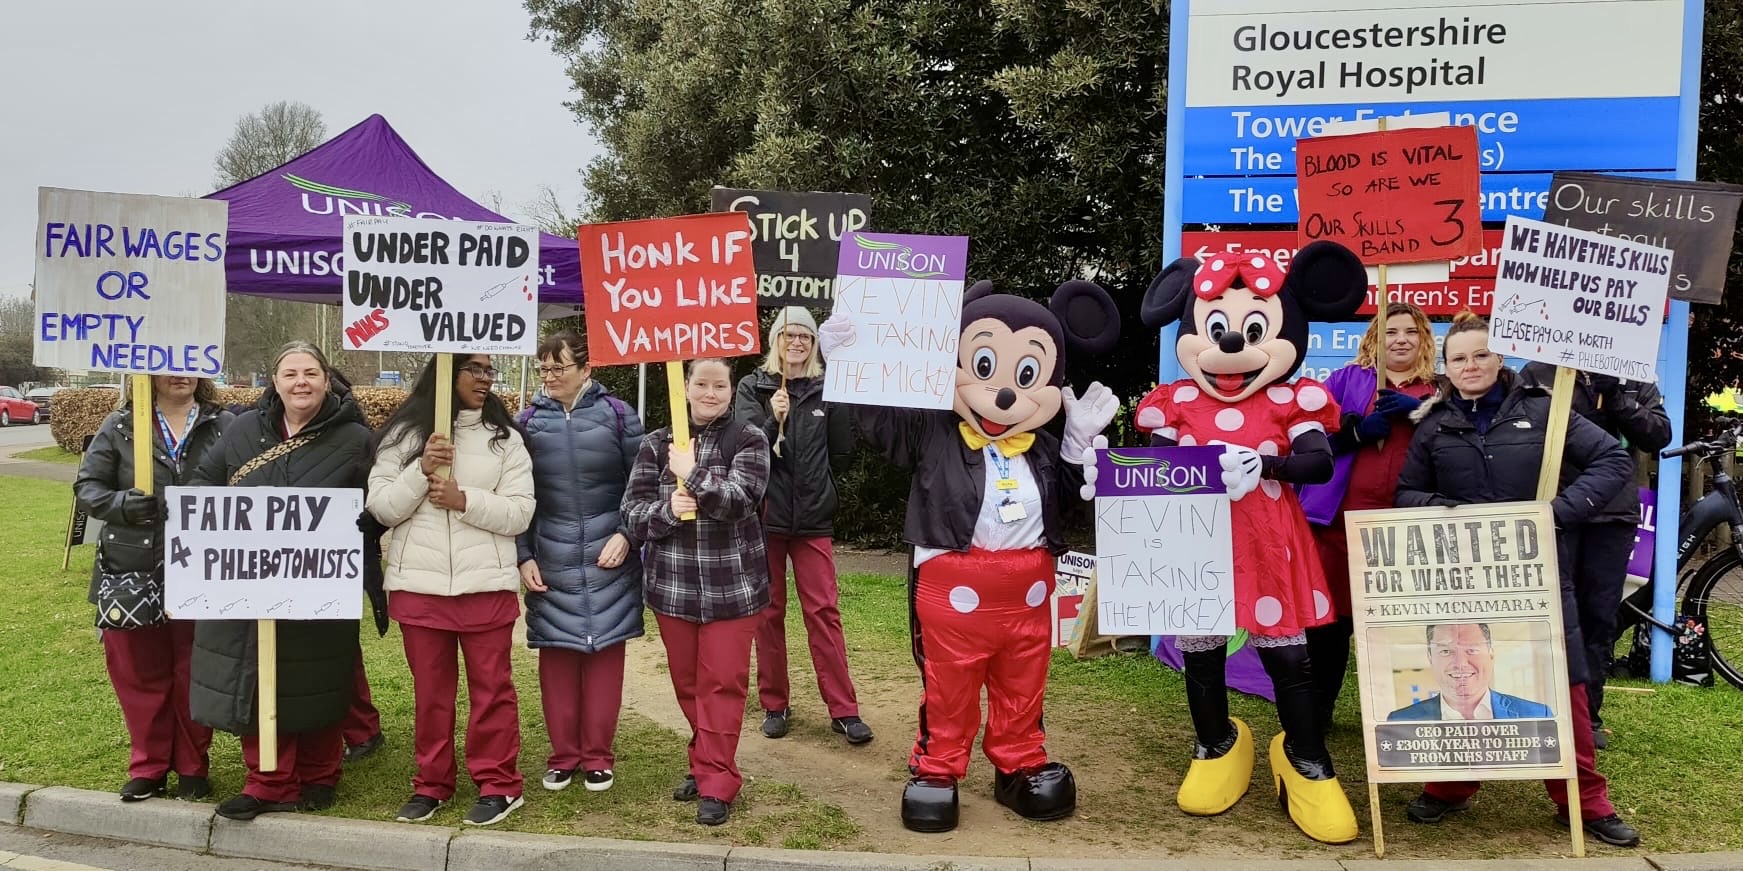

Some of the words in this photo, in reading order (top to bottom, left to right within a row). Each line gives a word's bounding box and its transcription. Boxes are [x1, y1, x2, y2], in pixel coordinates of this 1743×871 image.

[1233, 17, 1507, 52] Gloucestershire
[1232, 61, 1325, 97] Royal
[1339, 56, 1485, 94] Hospital
[1231, 146, 1282, 170] The
[1304, 153, 1361, 177] BLOOD
[1371, 152, 1388, 166] IS
[1402, 144, 1463, 165] VITAL
[1229, 188, 1283, 213] The
[1480, 187, 1549, 211] entre
[1327, 182, 1353, 197] SO
[1365, 177, 1400, 193] ARE
[1409, 172, 1441, 187] WE
[1555, 183, 1620, 216] Our
[1627, 192, 1715, 223] skills
[828, 208, 867, 241] UP
[1305, 213, 1345, 239] OUR
[1351, 211, 1405, 238] SKILLS
[1362, 239, 1420, 257] BAND
[1431, 199, 1464, 246] 3
[46, 222, 116, 258] FAIR
[121, 226, 222, 262] WAGES
[353, 231, 450, 265] UNDER
[459, 233, 529, 268] PAID
[601, 231, 700, 274] HONK
[711, 231, 748, 265] IF
[779, 239, 799, 272] 4
[1511, 225, 1540, 253] WE
[1543, 231, 1588, 263] HAVE
[1588, 241, 1615, 267] THE
[1616, 247, 1669, 275] SKILLS
[858, 251, 946, 273] UNISON
[96, 270, 151, 300] OR
[348, 270, 443, 311] UNDER
[602, 277, 662, 313] YOU
[676, 276, 751, 308] LIKE
[1502, 259, 1539, 284] NOW
[1540, 266, 1580, 291] HELP
[1580, 273, 1601, 293] US
[1605, 277, 1638, 299] PAY
[835, 277, 963, 320] KEVIN
[1573, 296, 1601, 317] OUR
[1605, 301, 1650, 327] BILLS
[41, 312, 144, 343] EMPTY
[345, 308, 389, 348] NHS
[420, 311, 526, 342] VALUED
[605, 319, 755, 357] VAMPIRES
[868, 321, 957, 353] TAKING
[1493, 317, 1531, 342] PLEASE
[1532, 325, 1551, 344] PAY
[1552, 329, 1574, 344] OUR
[1579, 332, 1613, 350] WORTH
[91, 343, 221, 375] NEEDLES
[830, 359, 876, 393] THE
[1115, 466, 1207, 488] UNISON
[180, 495, 253, 531] FAIR
[266, 494, 332, 531] PAY
[1097, 498, 1218, 538] KEVIN
[170, 535, 192, 568] 4
[204, 547, 360, 580] PHLEBOTOMISTS
[1143, 538, 1163, 548] IS
[1360, 519, 1539, 567] WANTED
[1098, 554, 1226, 592] TAKING
[1364, 570, 1403, 593] FOR
[1411, 566, 1475, 592] WAGE
[1483, 563, 1544, 589] THEFT
[1101, 601, 1143, 628] THE
[1148, 594, 1233, 633] MICKEY
[1380, 602, 1430, 616] KEVIN
[1396, 738, 1480, 751] £300K/YEAR
[1482, 738, 1502, 749] TO
[1505, 736, 1541, 748] HIDE
[1415, 726, 1443, 738] CEO
[1444, 725, 1479, 737] PAID
[1481, 724, 1519, 736] OVER
[1410, 751, 1452, 763] FROM
[1453, 750, 1483, 762] NHS
[1485, 750, 1528, 762] STAFF
